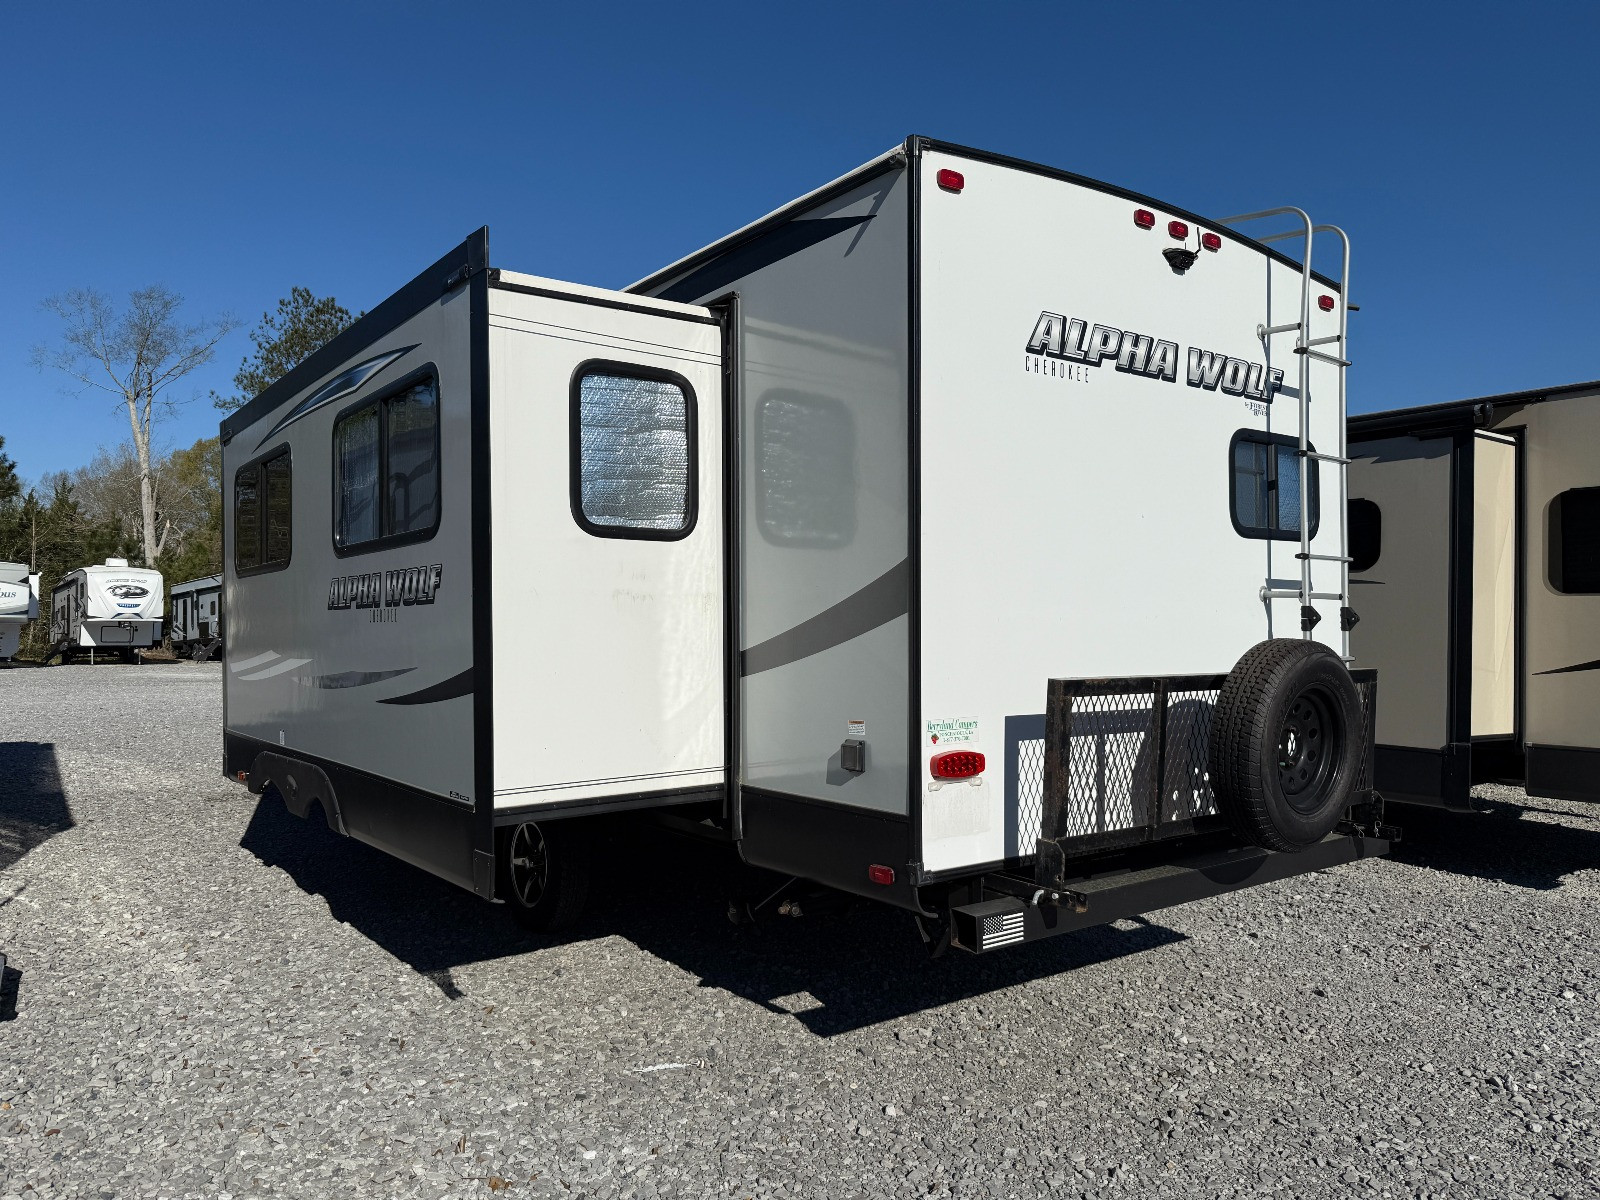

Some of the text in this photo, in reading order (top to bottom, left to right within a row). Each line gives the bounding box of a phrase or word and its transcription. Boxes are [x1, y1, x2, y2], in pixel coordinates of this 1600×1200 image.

[1025, 310, 1285, 404] ALPHA WOLF
[1025, 355, 1089, 383] CHEROKEE
[327, 563, 443, 611] ALPHA WOLF
